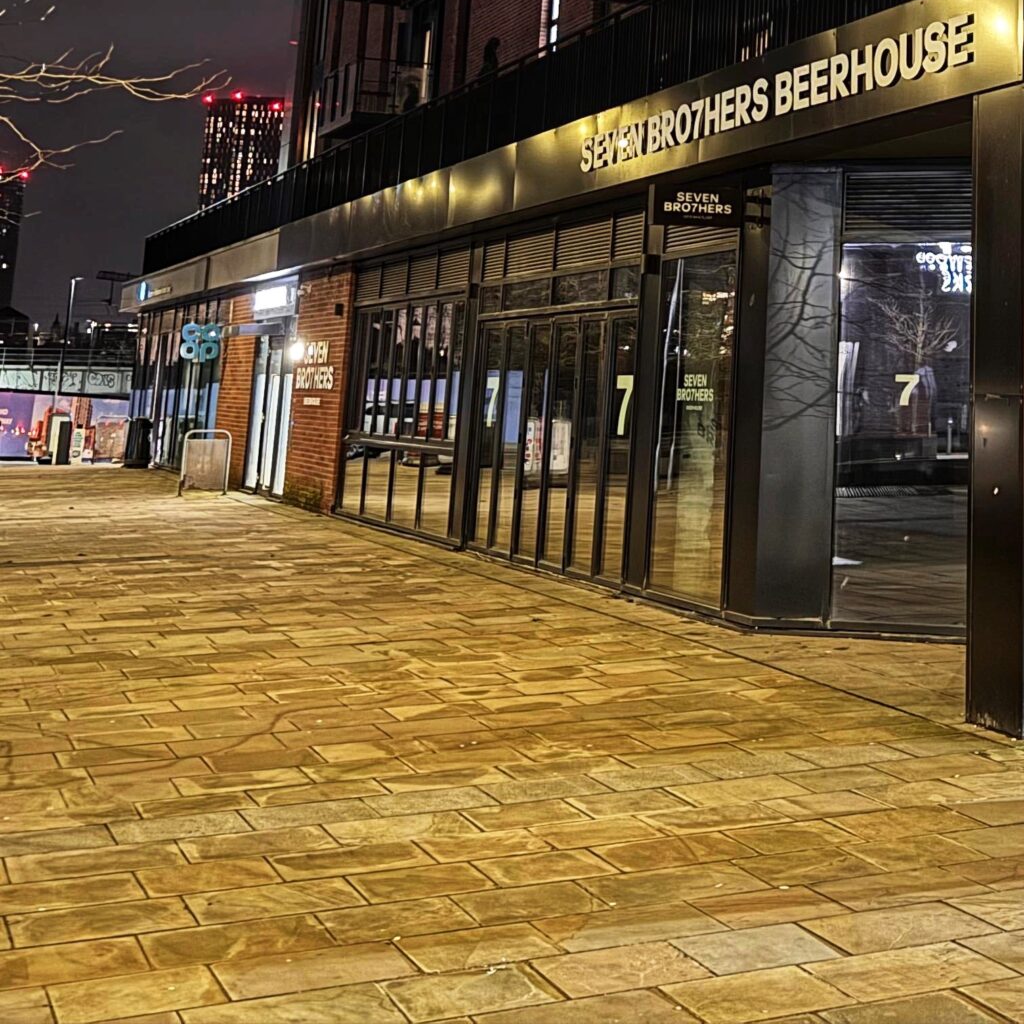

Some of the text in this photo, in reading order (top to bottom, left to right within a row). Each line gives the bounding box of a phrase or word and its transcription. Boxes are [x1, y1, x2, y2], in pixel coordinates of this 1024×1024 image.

[580, 120, 642, 173] SEVEN
[775, 14, 975, 116] BEERHOUSE
[676, 191, 719, 203] SEVEN
[684, 374, 708, 387] SEVEN
[895, 374, 920, 406] 7
[486, 376, 500, 427] 7
[616, 375, 634, 435] 7
